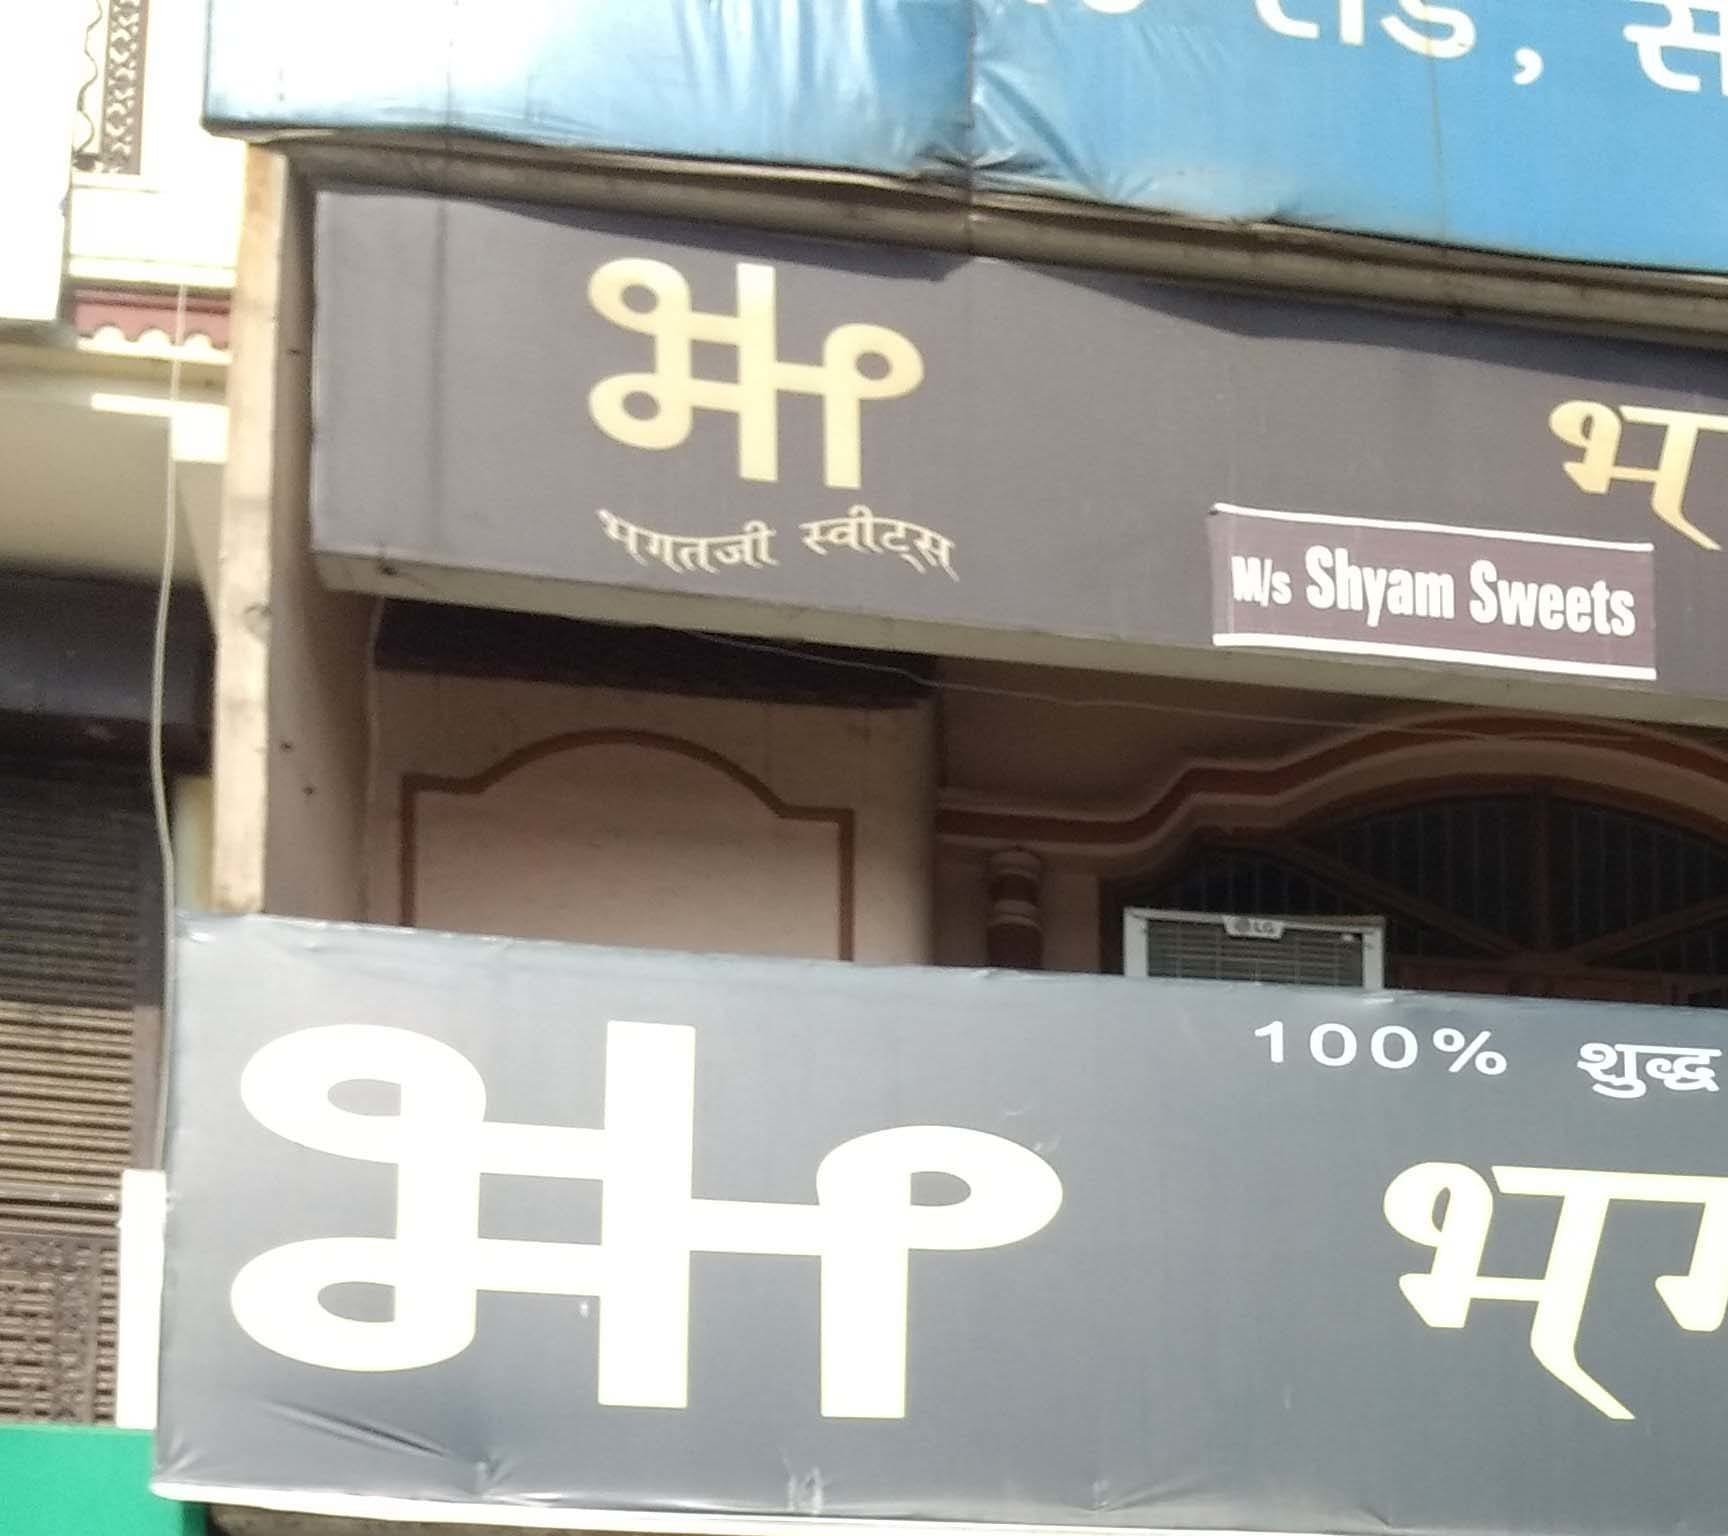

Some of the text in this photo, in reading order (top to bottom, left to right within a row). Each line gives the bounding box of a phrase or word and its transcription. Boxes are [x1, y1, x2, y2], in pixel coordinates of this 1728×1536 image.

[1231, 545, 1636, 637] M/s Shyam Sweets
[1254, 1020, 1508, 1076] 100%
[1577, 1042, 1722, 1099] शुद्ध
